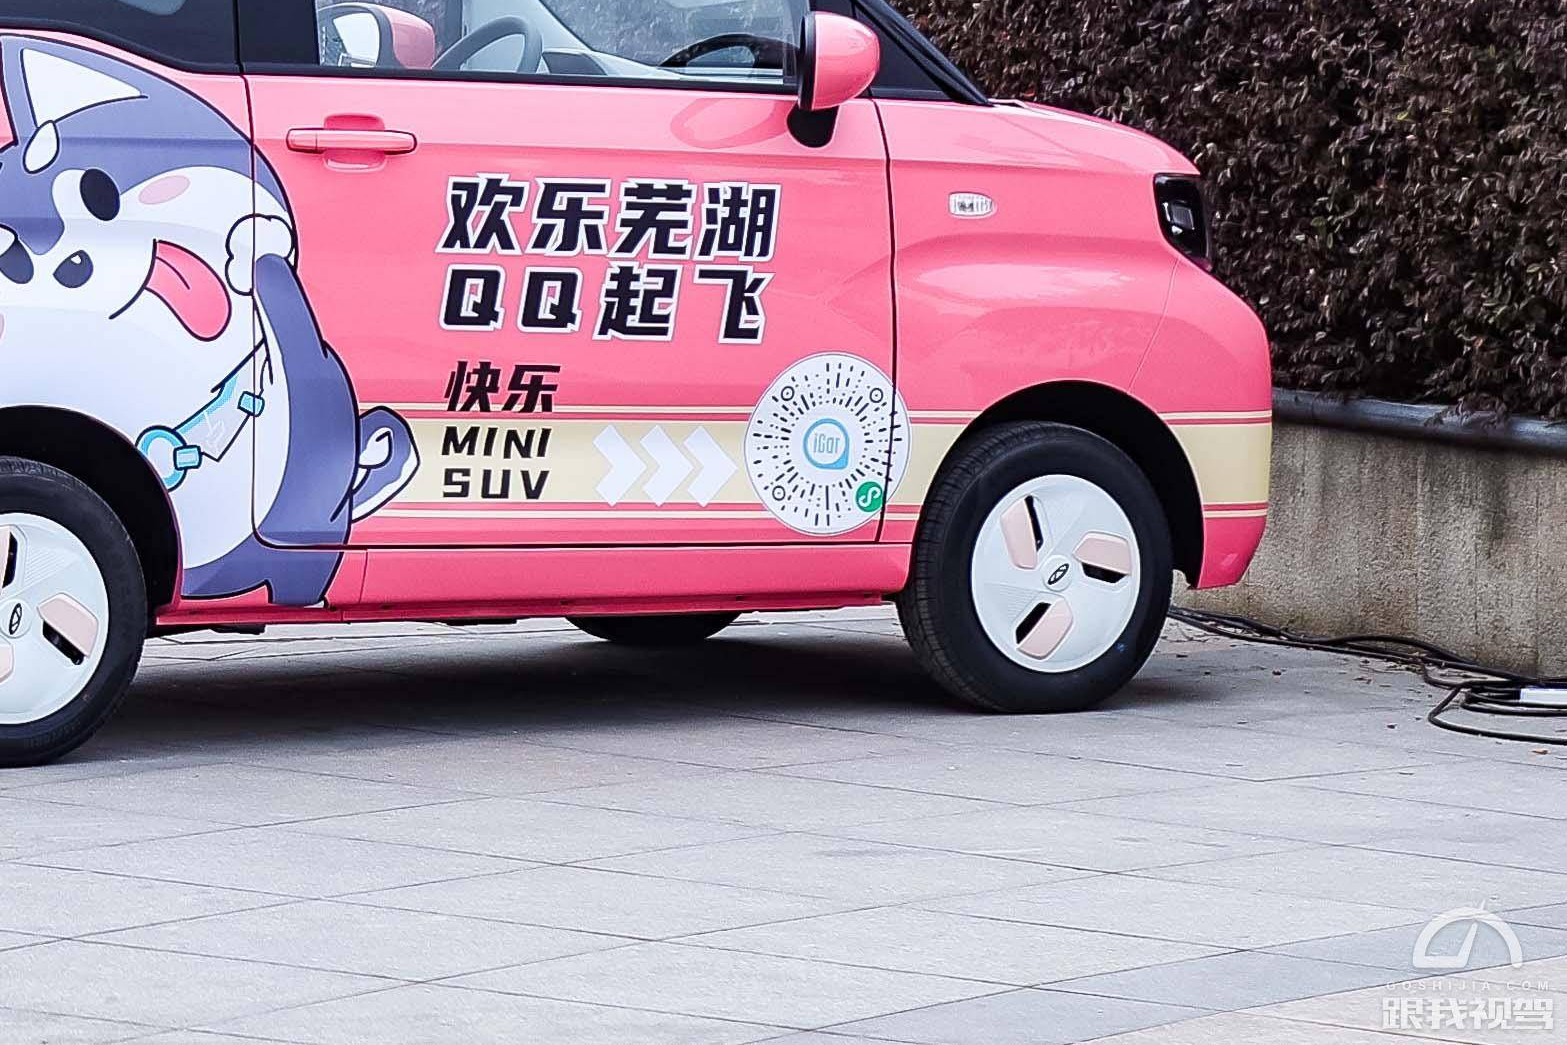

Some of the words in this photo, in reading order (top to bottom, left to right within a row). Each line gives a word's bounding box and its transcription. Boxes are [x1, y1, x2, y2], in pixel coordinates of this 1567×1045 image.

[437, 174, 779, 260] 欢乐芜湖
[444, 360, 561, 413] 快乐
[441, 426, 553, 460] MINI
[442, 467, 551, 500] SUV
